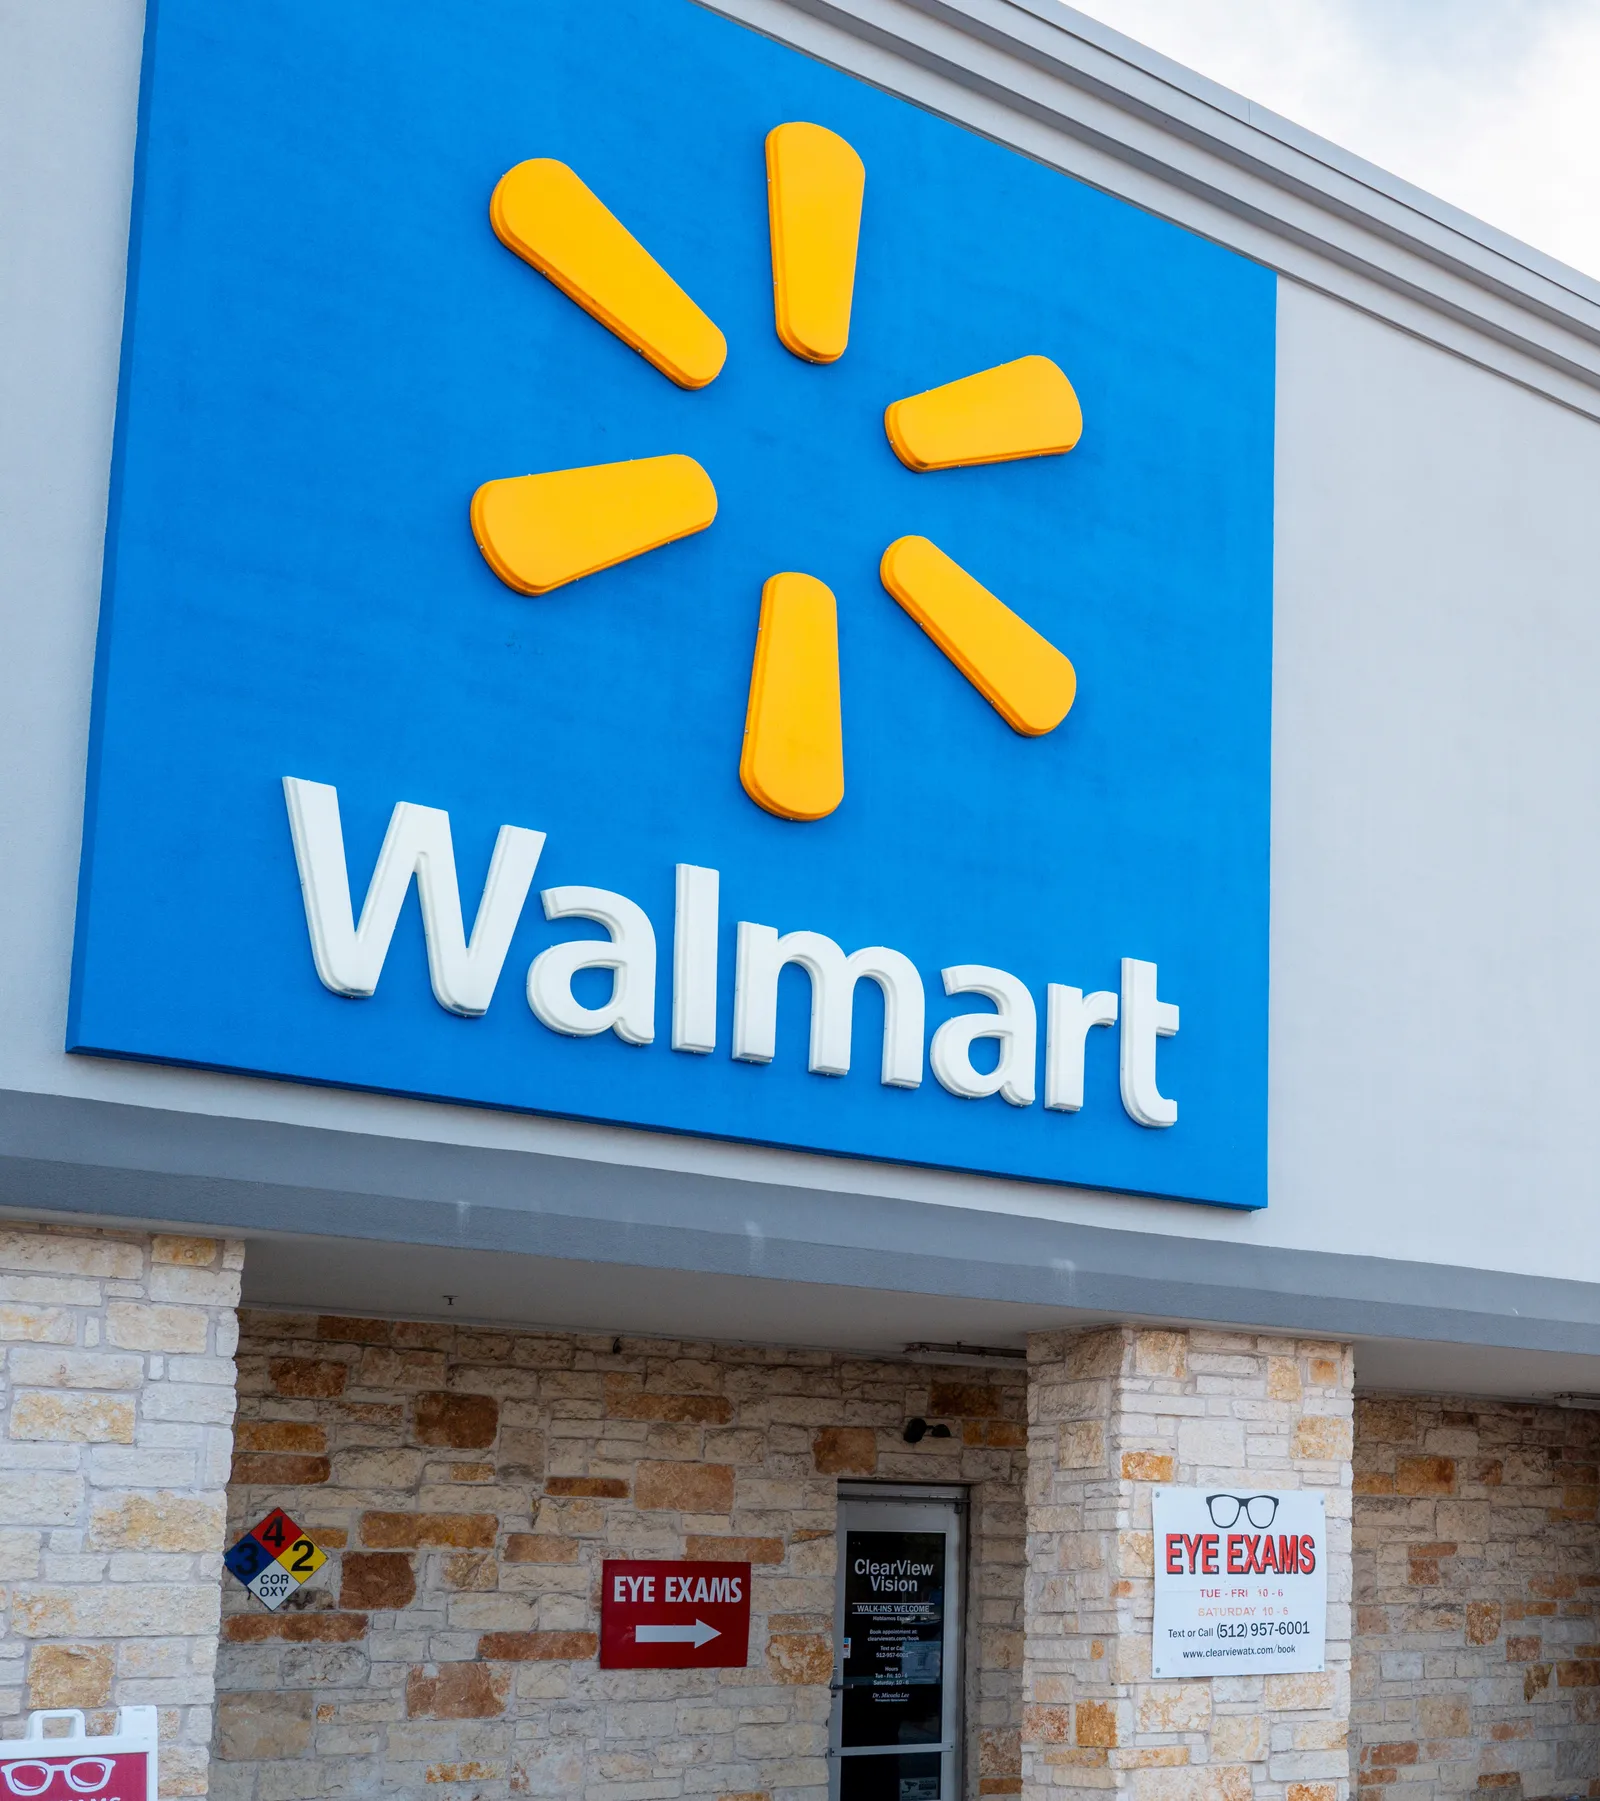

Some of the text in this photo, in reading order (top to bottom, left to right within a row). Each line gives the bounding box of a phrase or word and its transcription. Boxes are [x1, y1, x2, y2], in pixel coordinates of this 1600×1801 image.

[281, 775, 1180, 1129] Walmart
[262, 1516, 286, 1548] 4
[236, 1543, 259, 1575] 3
[291, 1540, 314, 1571] 2
[1165, 1533, 1316, 1575] EYE EXAMS
[854, 1558, 934, 1576] ClearView
[260, 1574, 289, 1584] COR
[870, 1576, 918, 1592] Vision
[260, 1586, 287, 1597] OXY
[614, 1576, 742, 1603] EYE EXAMS
[1200, 1589, 1221, 1598] TUE
[1231, 1589, 1248, 1598] FRI
[1258, 1589, 1269, 1598] 10
[1277, 1588, 1284, 1597] 6
[857, 1605, 930, 1613] WALK-INS WELCOME
[1198, 1607, 1256, 1617] SATURDAY
[1262, 1607, 1274, 1616] 10
[1282, 1607, 1289, 1616] 6
[1168, 1621, 1310, 1639] Text or Call (512) 957-6001
[1183, 1644, 1296, 1659] www.clearviewatx.com/book
